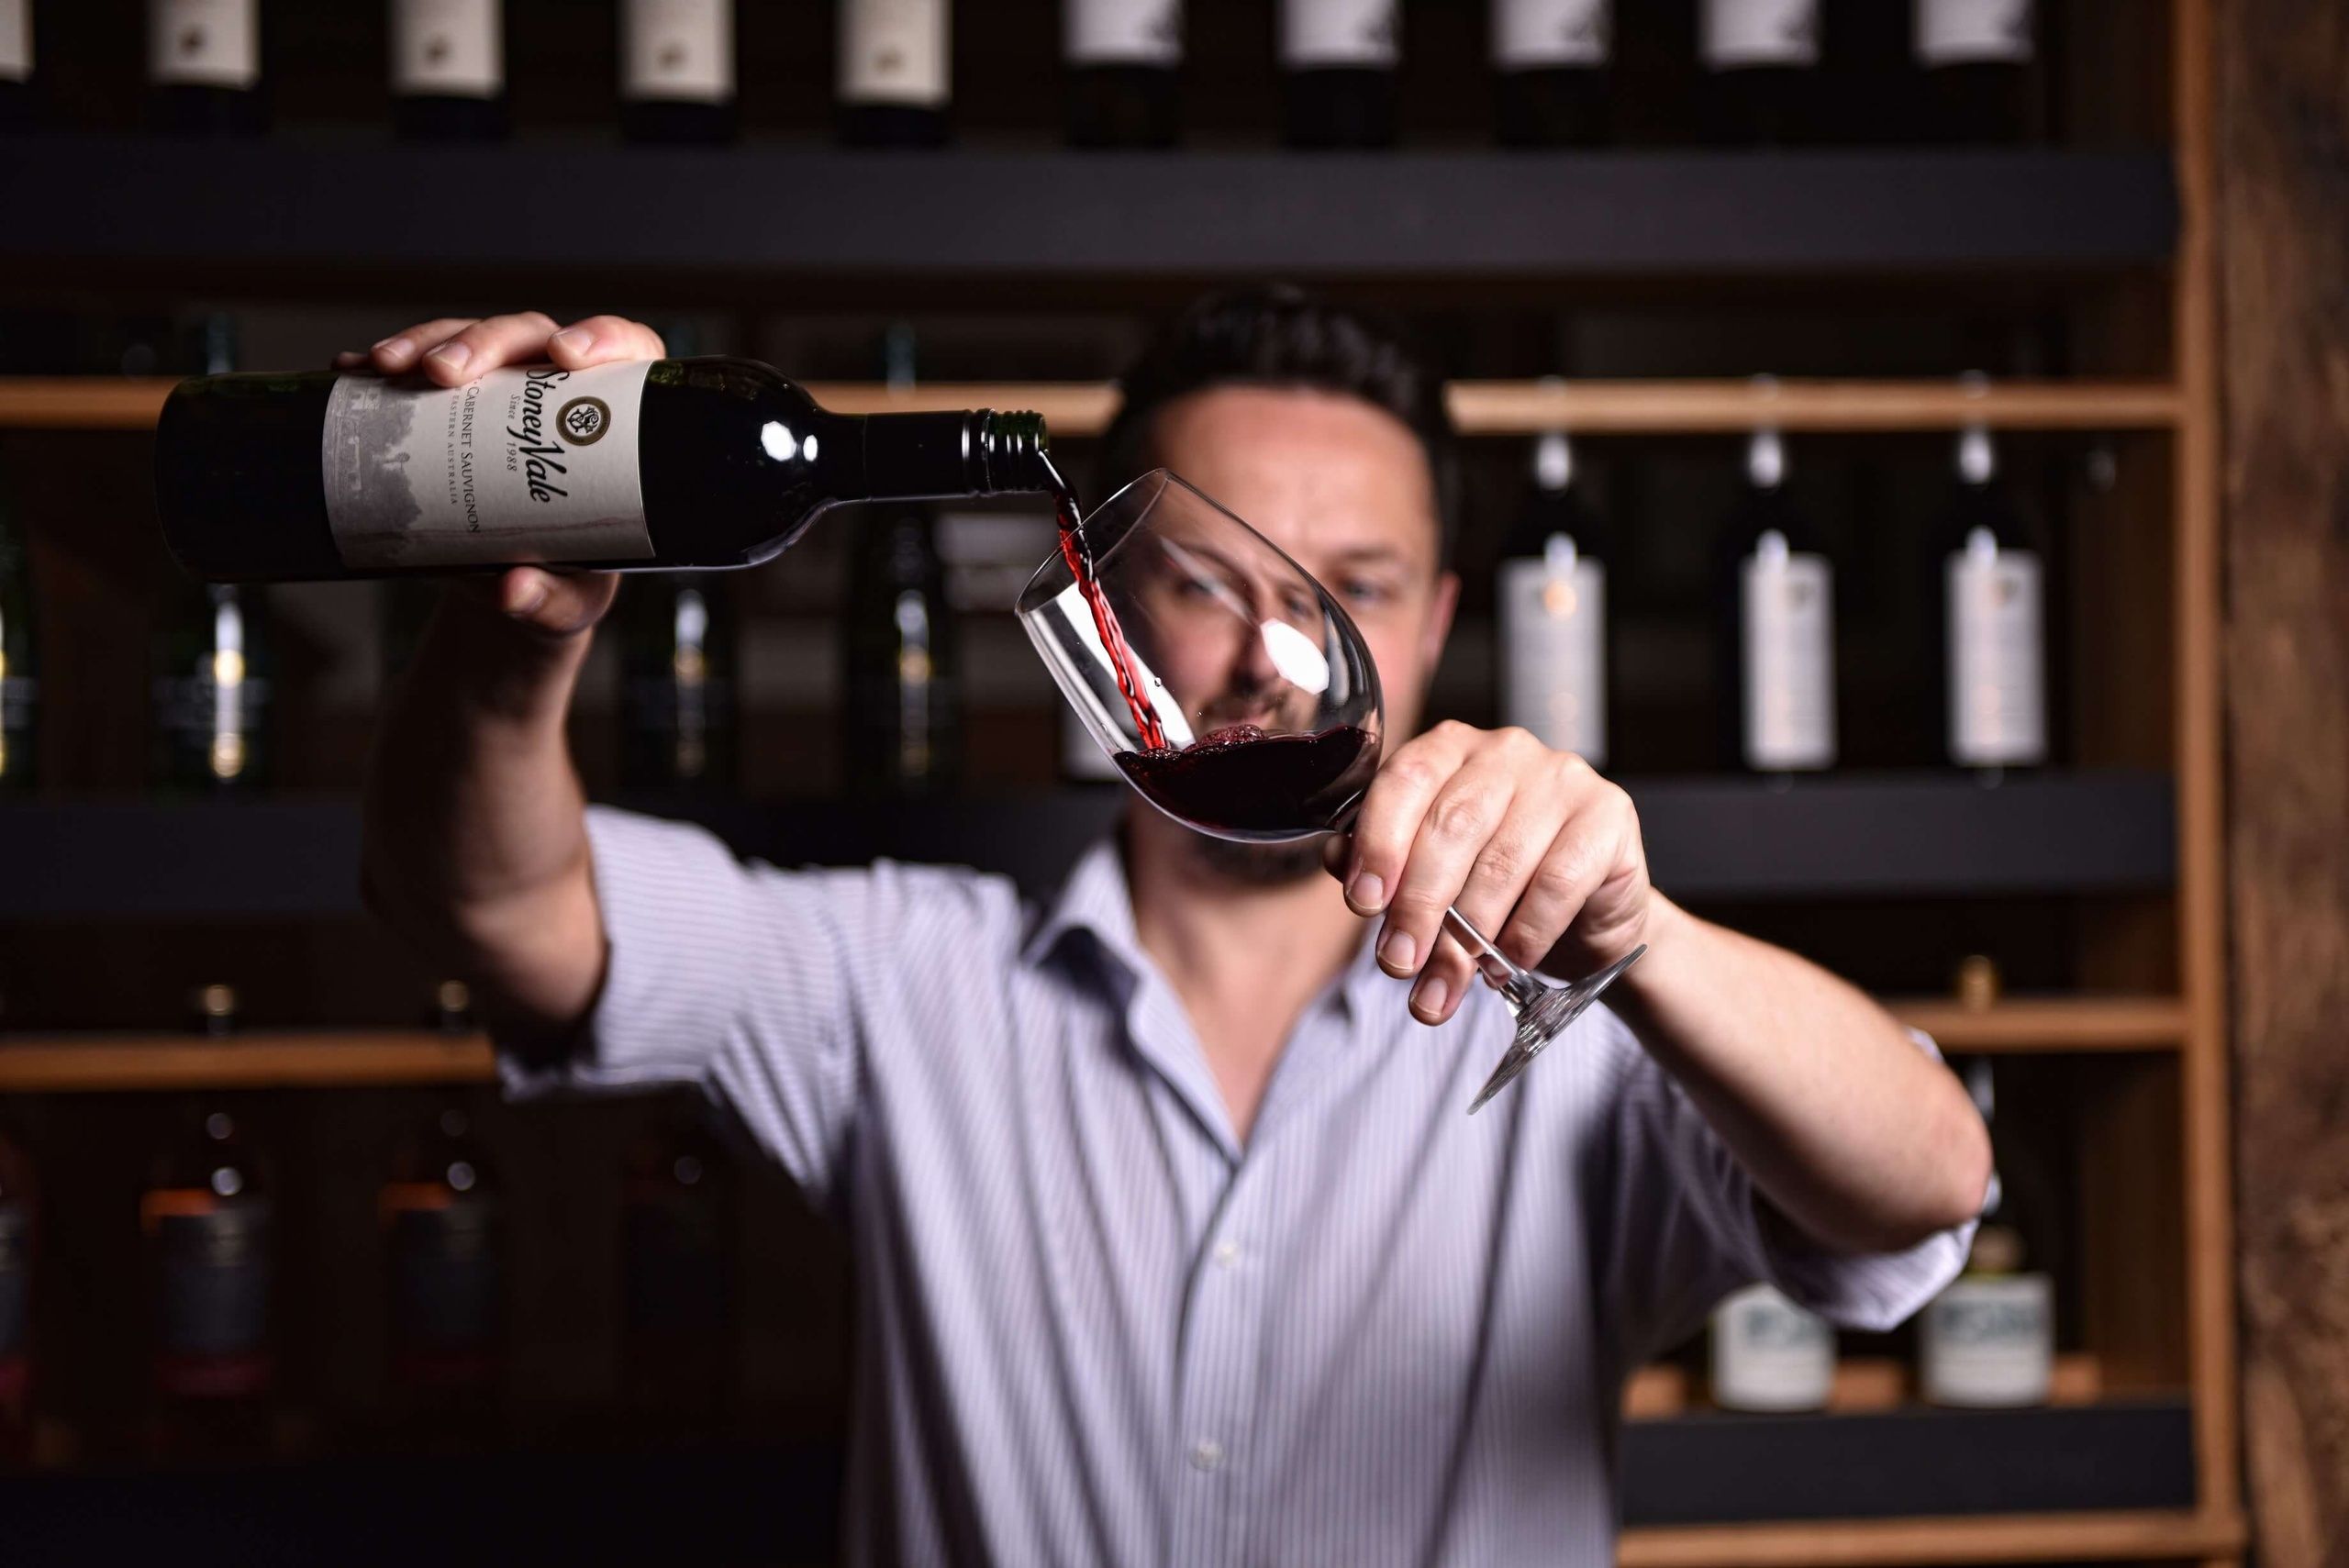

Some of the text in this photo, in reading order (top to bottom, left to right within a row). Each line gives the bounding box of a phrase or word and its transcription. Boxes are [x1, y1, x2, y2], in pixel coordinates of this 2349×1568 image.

[448, 395, 459, 438] EASTERN
[507, 394, 520, 472] Since 1988
[447, 442, 458, 506] AUSTRALIA
[461, 386, 481, 533] CABERNET SAUVIGNON
